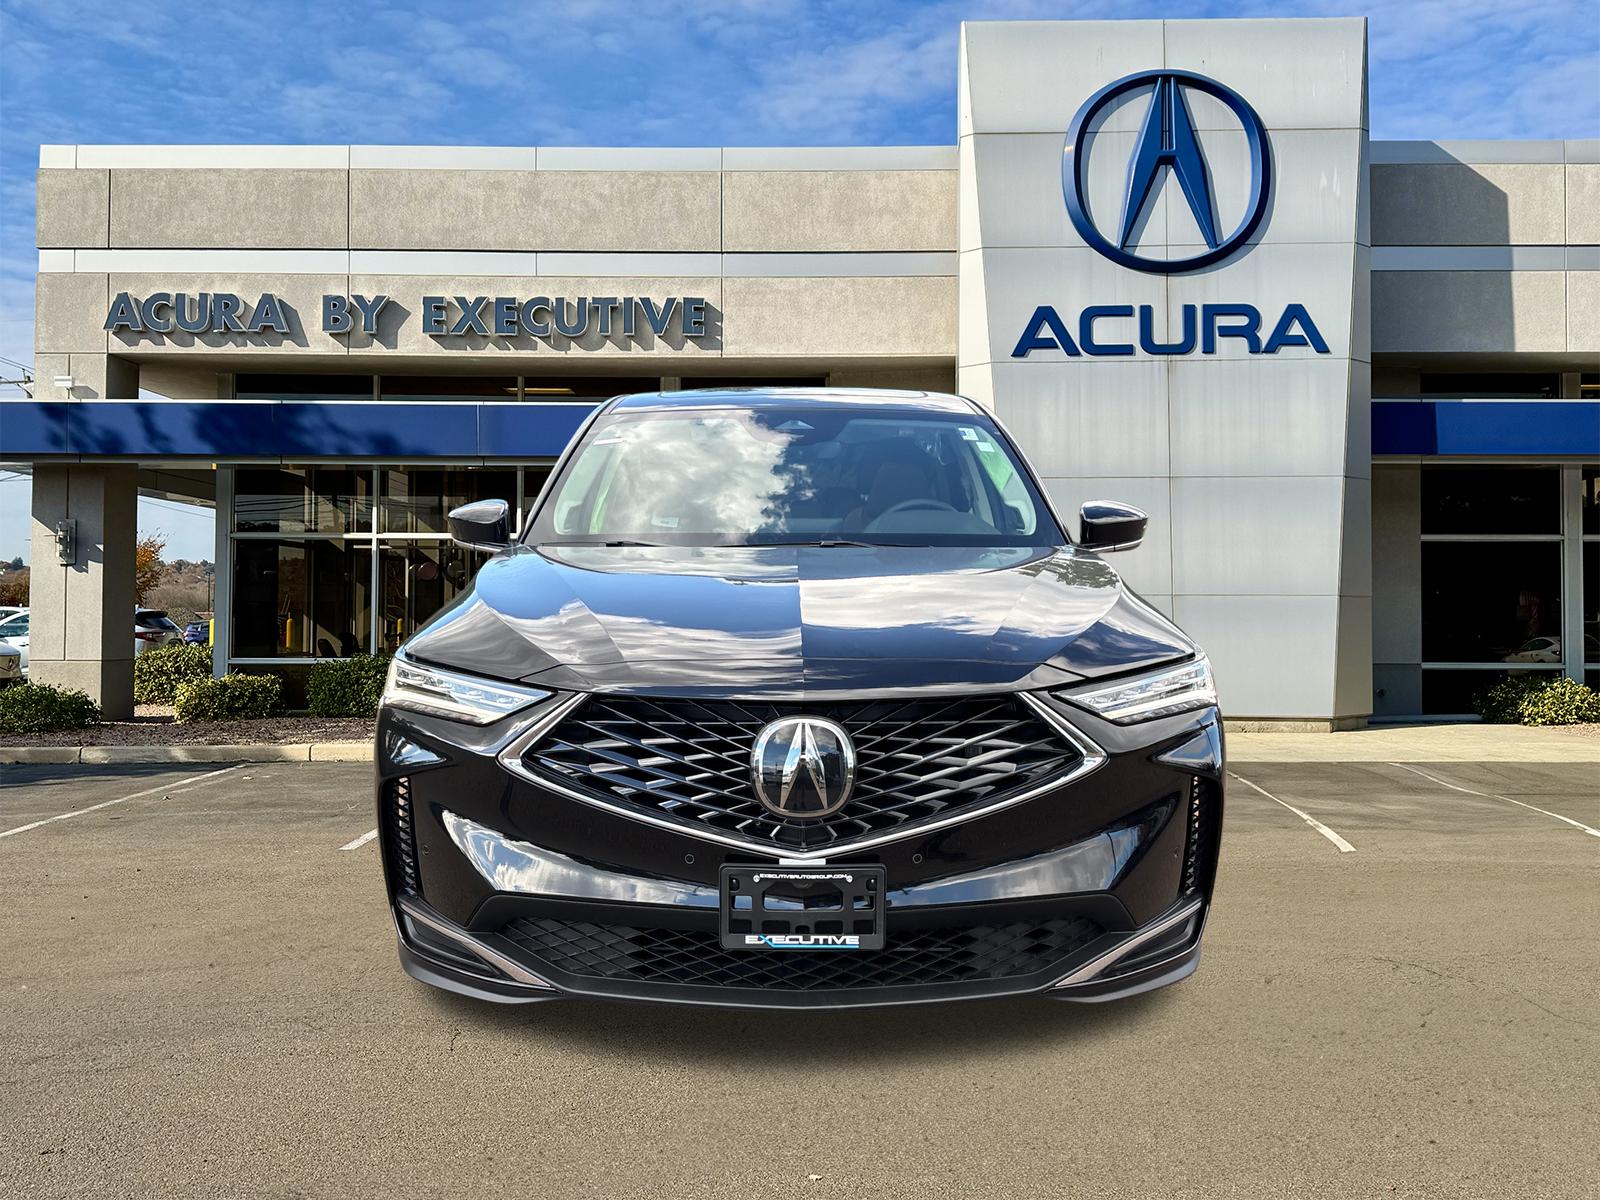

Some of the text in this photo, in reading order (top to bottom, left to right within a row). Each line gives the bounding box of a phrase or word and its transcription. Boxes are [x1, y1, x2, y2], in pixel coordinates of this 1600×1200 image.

[103, 292, 706, 336] ACURA BY EXECUTIVE
[1010, 303, 1332, 357] ACURA
[745, 935, 859, 947] EXECUTIVE
